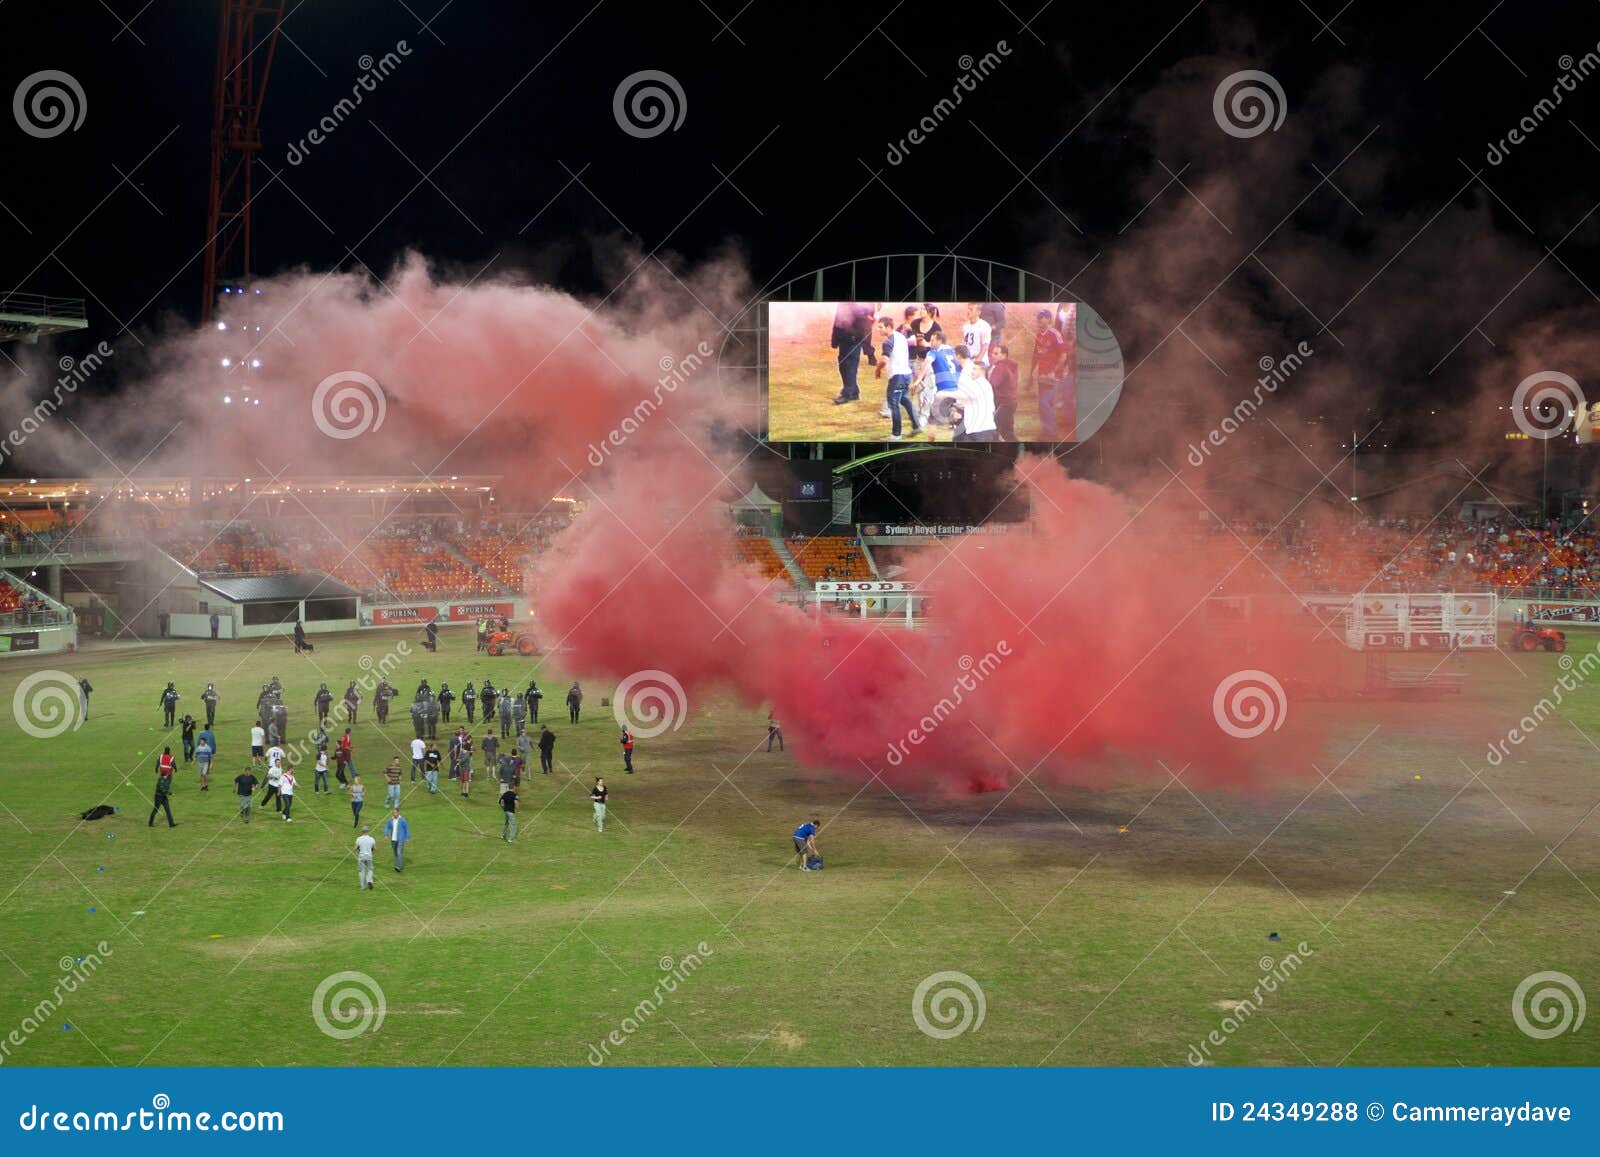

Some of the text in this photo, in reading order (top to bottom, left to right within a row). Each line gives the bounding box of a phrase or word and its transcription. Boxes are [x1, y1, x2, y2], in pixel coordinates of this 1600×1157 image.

[885, 525, 913, 535] Sydney
[915, 525, 937, 535] Royal
[938, 525, 964, 534] Easter
[836, 583, 917, 591] RODE
[388, 609, 417, 617] PURINA
[464, 606, 495, 614] PURINA
